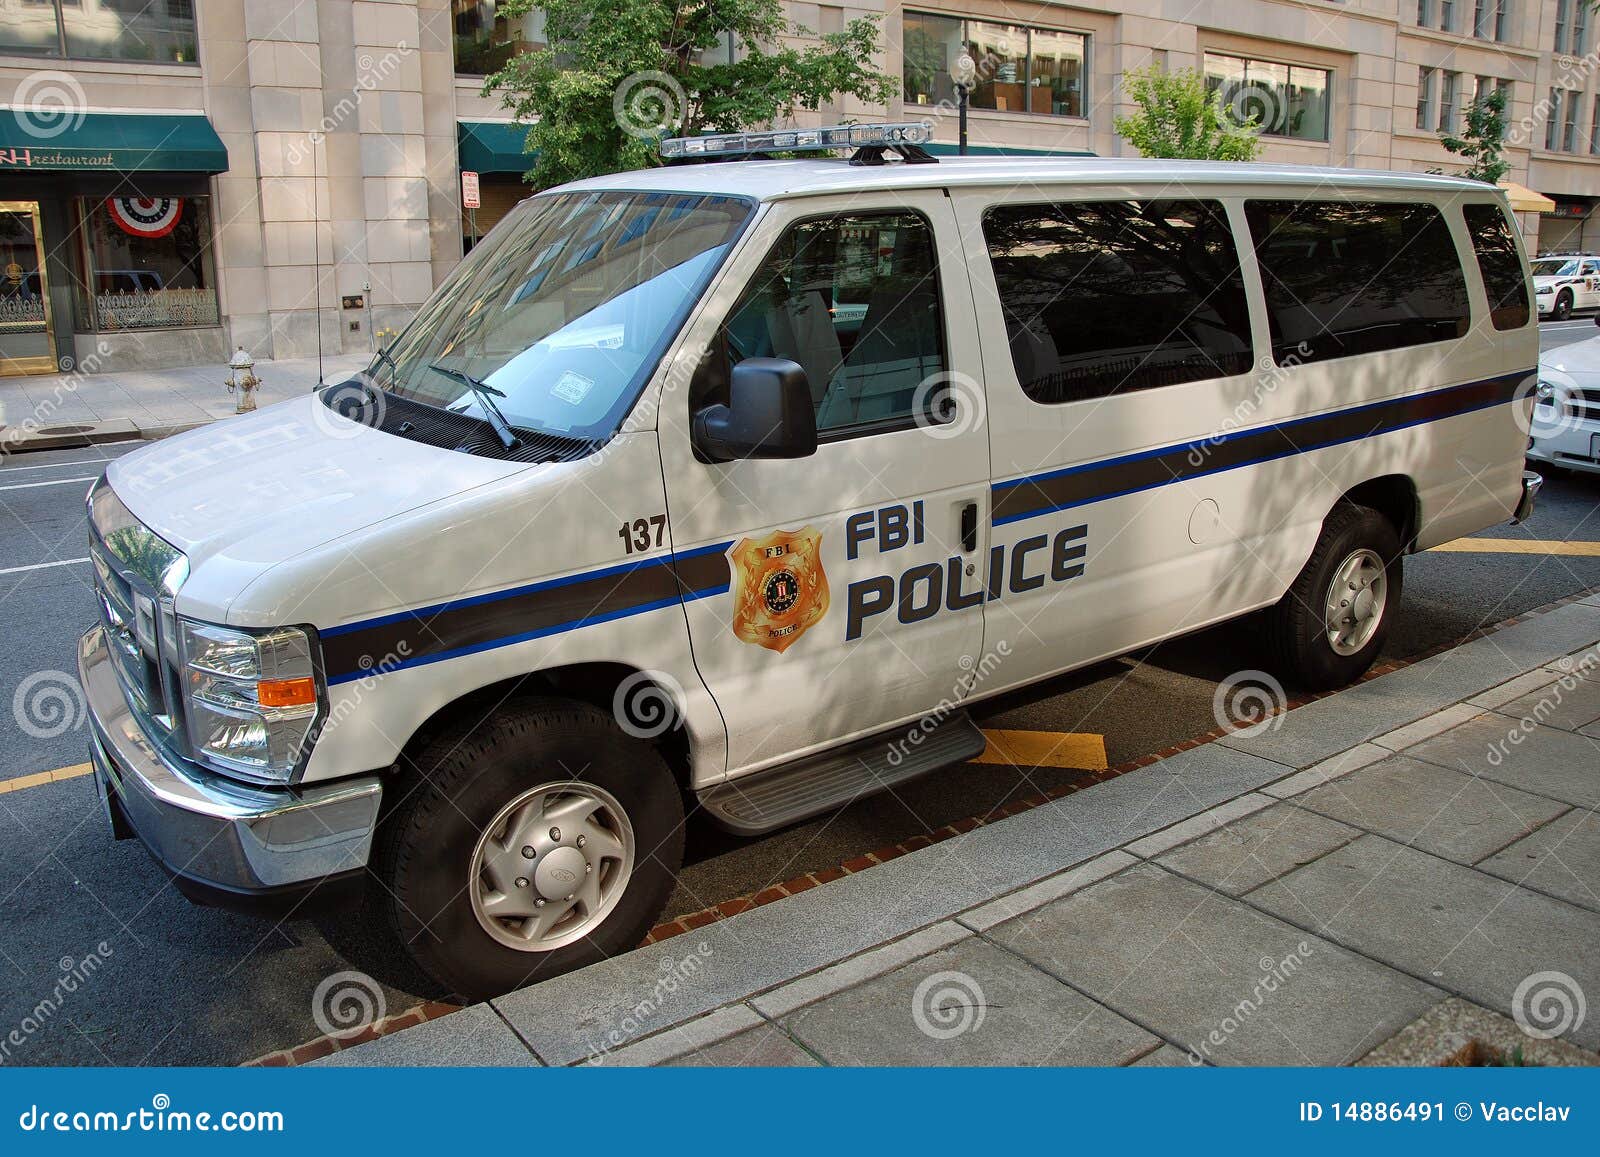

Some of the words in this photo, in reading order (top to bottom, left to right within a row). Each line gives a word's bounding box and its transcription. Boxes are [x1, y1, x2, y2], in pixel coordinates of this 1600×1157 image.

[31, 152, 114, 166] restaurant
[618, 513, 666, 555] 137
[845, 499, 925, 561] FBI
[765, 543, 791, 559] FBI
[845, 523, 1089, 642] POLICE
[768, 623, 798, 638] POLICE
